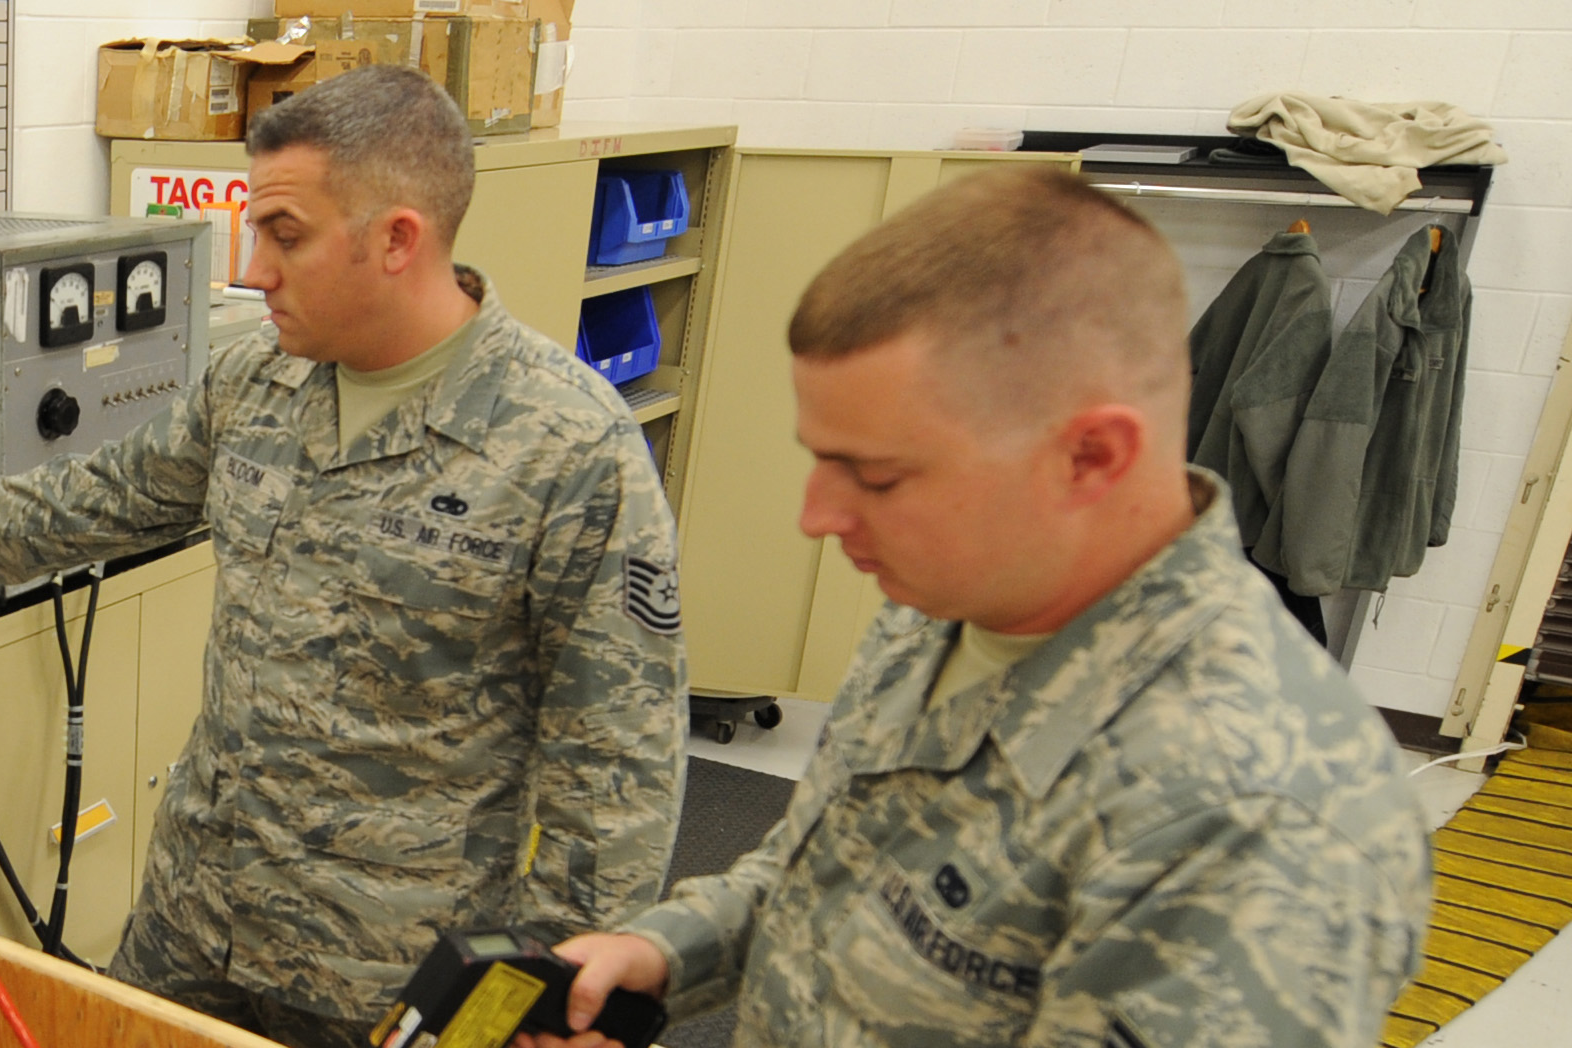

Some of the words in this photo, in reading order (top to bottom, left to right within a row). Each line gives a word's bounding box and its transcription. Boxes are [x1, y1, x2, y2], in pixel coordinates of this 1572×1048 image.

[150, 176, 215, 210] TAG
[225, 459, 267, 488] BLOOM
[380, 516, 405, 540] U.S.
[416, 525, 440, 546] AIR
[448, 532, 505, 561] FORCE
[927, 929, 1041, 996] FORCE
